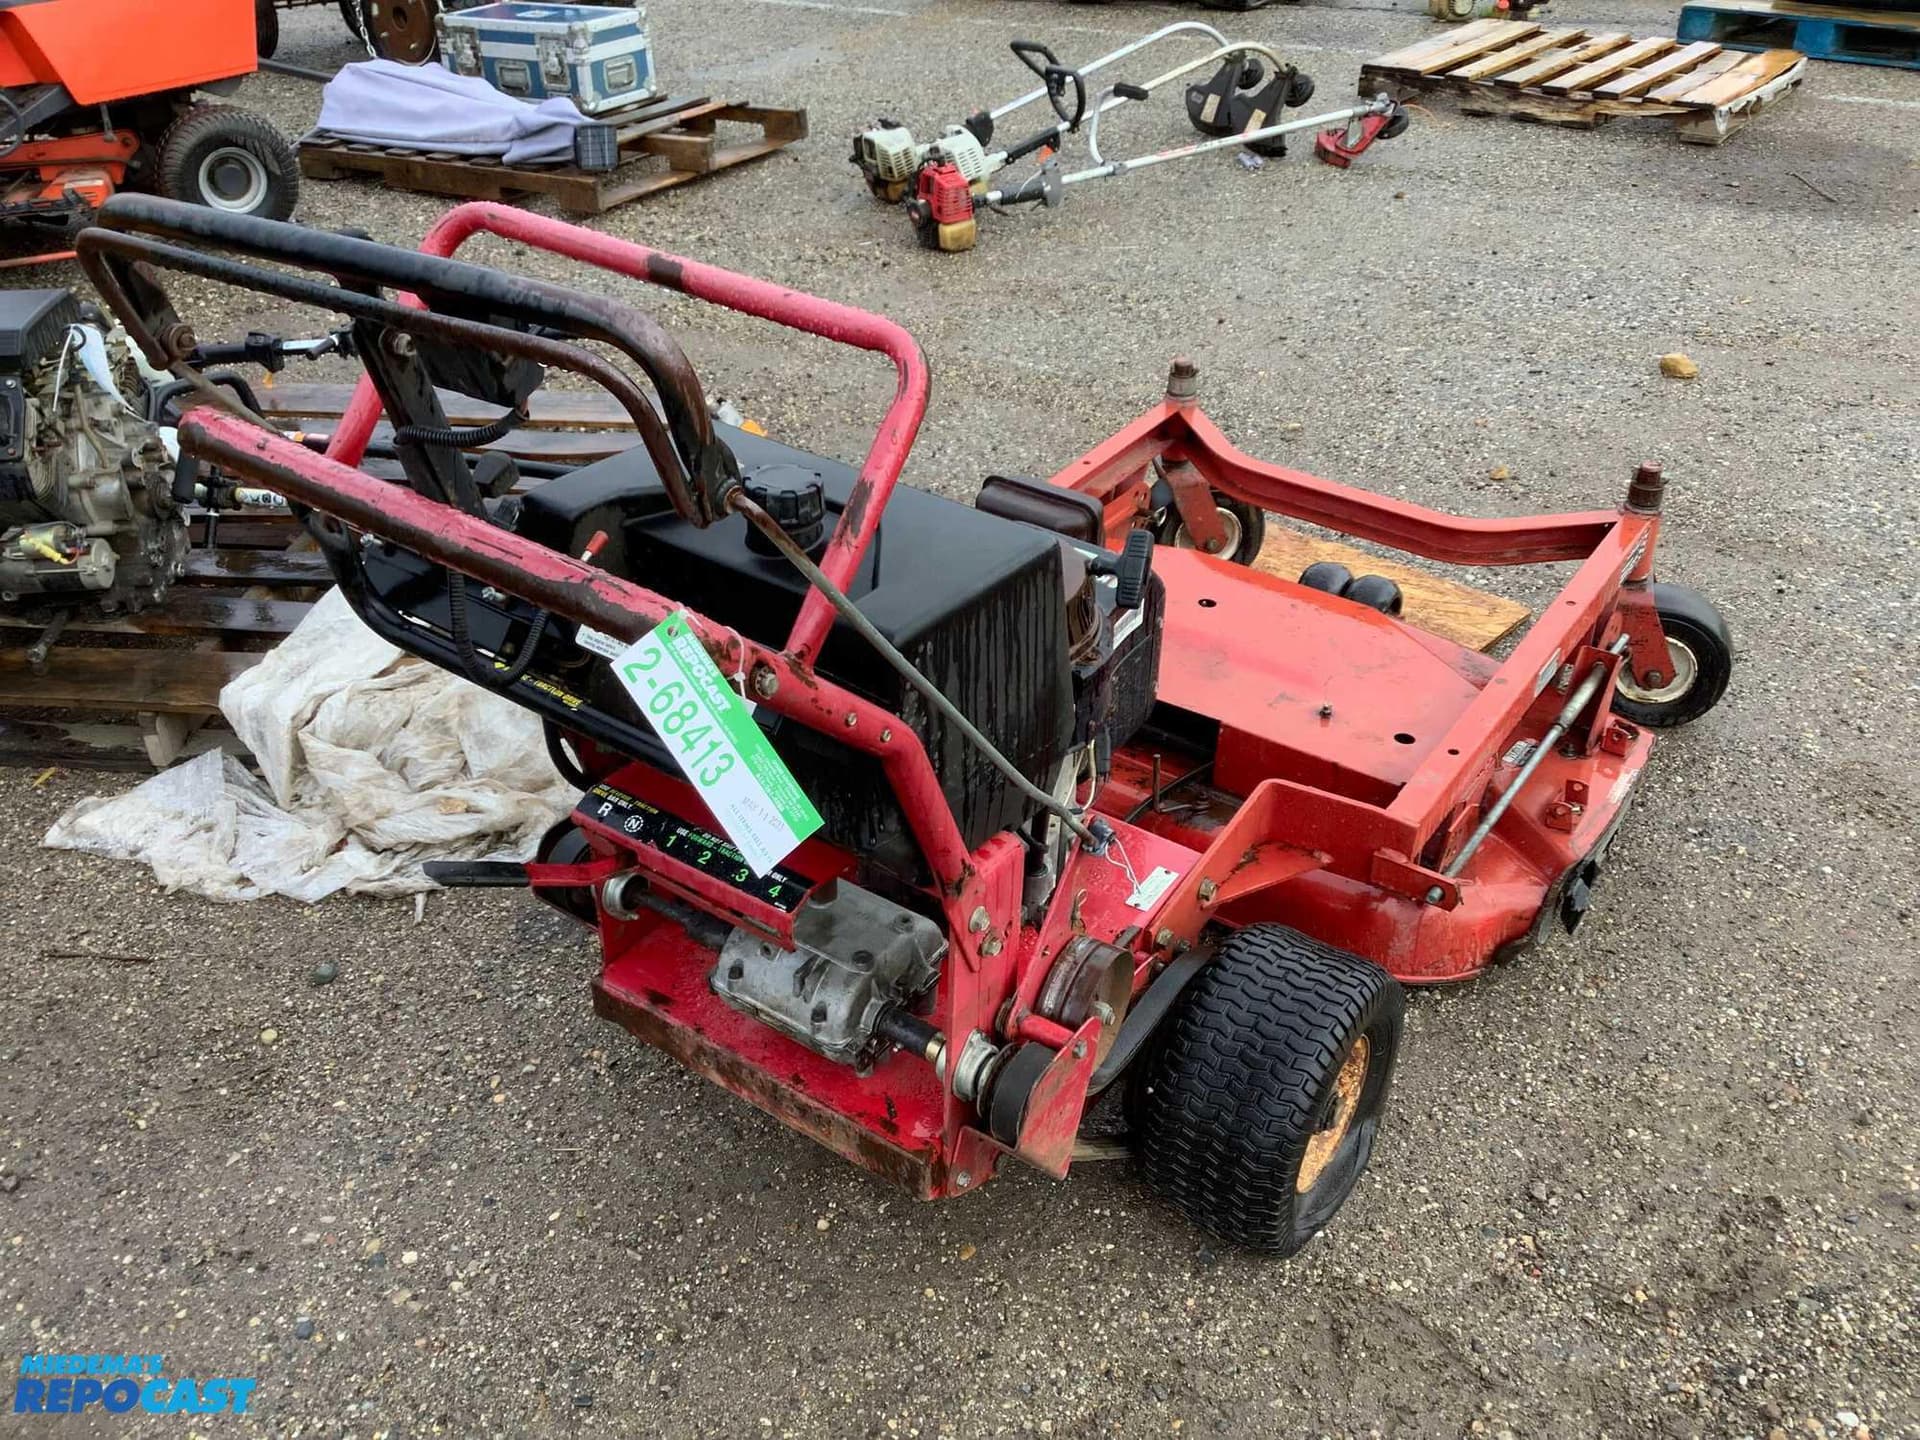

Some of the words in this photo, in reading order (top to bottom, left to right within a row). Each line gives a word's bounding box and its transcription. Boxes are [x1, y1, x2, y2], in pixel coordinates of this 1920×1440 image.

[672, 637, 731, 712] REPOCAST
[622, 647, 735, 788] 2-68413
[597, 802, 612, 816] R
[666, 835, 677, 847] 1
[697, 850, 712, 865] 2
[735, 868, 749, 882] 3
[768, 884, 782, 898] 4
[676, 827, 690, 836] USE
